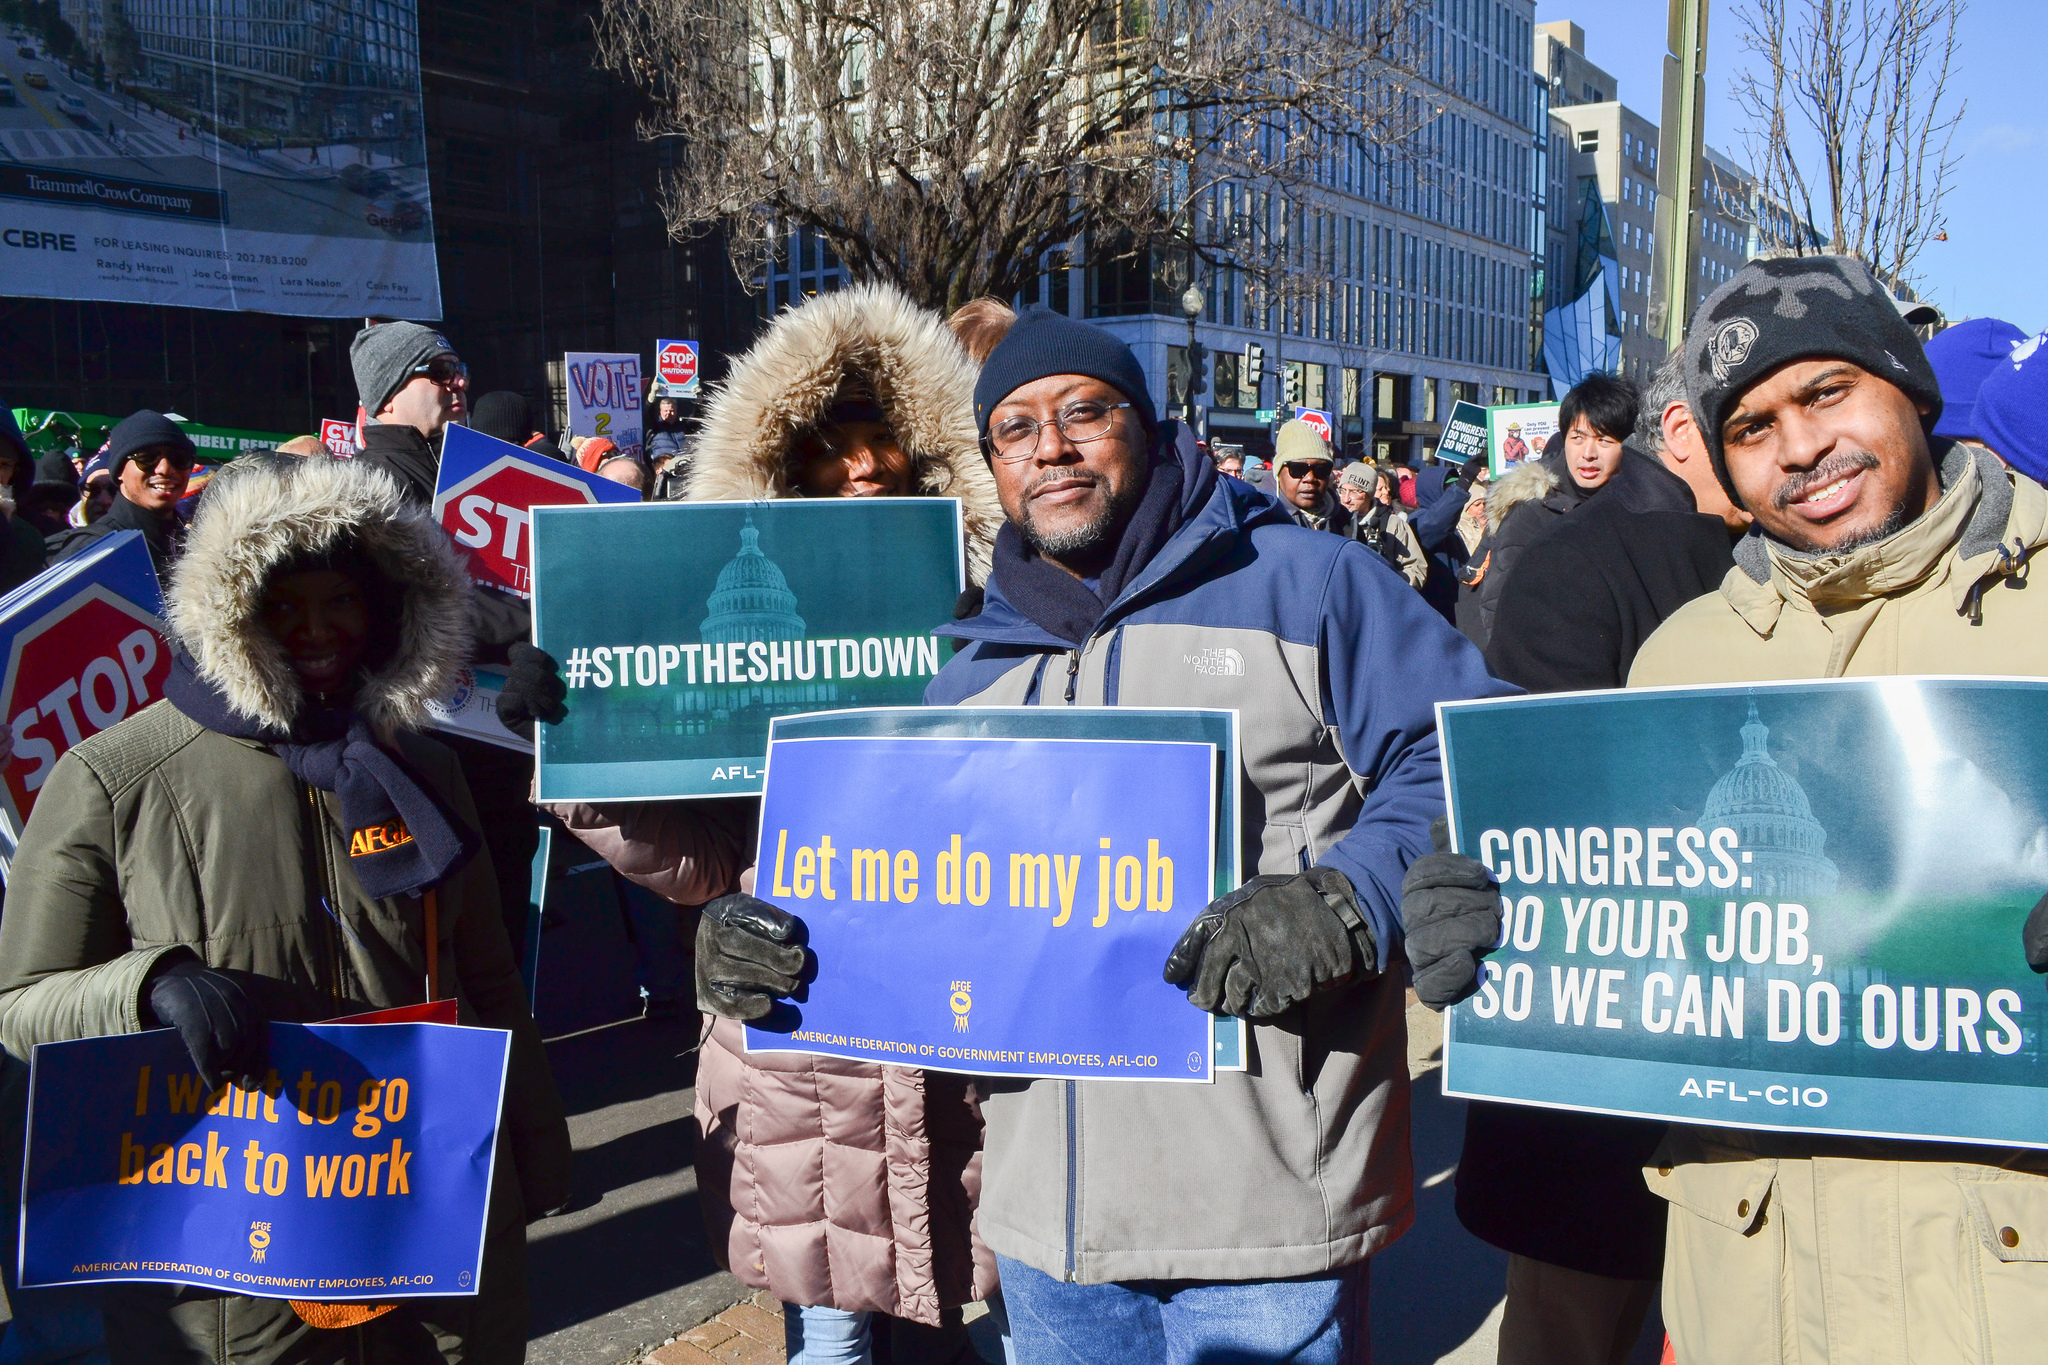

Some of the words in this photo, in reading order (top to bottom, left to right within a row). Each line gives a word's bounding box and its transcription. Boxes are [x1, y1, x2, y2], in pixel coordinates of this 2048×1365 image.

[3, 228, 77, 252] CBRE
[94, 237, 119, 248] FOR
[122, 240, 170, 254] LEASING
[236, 252, 308, 267] 202.783.8200
[96, 259, 132, 273] Randy
[136, 262, 174, 275] Harrell
[192, 269, 211, 279] Joe
[280, 277, 303, 287] Lara
[305, 278, 342, 288] Nealon
[366, 281, 389, 291] Colin
[392, 283, 409, 294] Fay
[661, 352, 695, 365] STOP
[570, 359, 640, 411] VOTE
[327, 424, 356, 441] CW
[595, 413, 612, 435] 2
[1450, 420, 1488, 438] CONGRESS
[185, 434, 236, 450] NBELT
[239, 438, 285, 452] RENT
[326, 438, 355, 455] STR
[1444, 439, 1454, 449] SO
[1455, 442, 1466, 454] WE
[1447, 430, 1457, 440] DO
[1459, 433, 1479, 446] YOUR
[1348, 474, 1370, 487] FLINT
[454, 494, 529, 560] ST
[1183, 654, 1225, 666] NORTH
[1203, 648, 1225, 657] THE
[565, 636, 939, 689] #STOPTHESHUTDOWN
[1194, 665, 1225, 676] FACE
[11, 628, 158, 792] STOP
[711, 765, 765, 781] AFL-
[1479, 826, 1753, 889] CONGRESS:
[772, 829, 836, 901] Let
[851, 847, 919, 904] me
[936, 834, 991, 907] do
[1009, 852, 1081, 928] my
[1092, 837, 1174, 928] job
[1560, 897, 1689, 960] YOUR
[1705, 901, 1824, 976] JOB,
[950, 980, 972, 992] AFGE
[1472, 960, 1534, 1022] SO
[1550, 965, 1626, 1029] WE
[1641, 971, 1745, 1039] CAN
[1767, 979, 1841, 1046] DO
[1861, 983, 2023, 1056] OURS
[791, 1030, 848, 1047] AMERICAN
[850, 1036, 917, 1055] FEDERATION
[920, 1044, 935, 1057] OF
[937, 1046, 1025, 1063] GOVERNMENT
[1028, 1051, 1105, 1068] EMPLOYEES,
[1107, 1054, 1158, 1067] AFL-CIO
[135, 1065, 150, 1117] I
[167, 1068, 283, 1124] want
[297, 1071, 342, 1125] to
[352, 1077, 410, 1138] go
[1679, 1077, 1829, 1108] AFL-CIO
[118, 1131, 230, 1189] back
[243, 1140, 289, 1196] to
[305, 1138, 413, 1198] work
[250, 1221, 272, 1232] AFGE
[72, 1261, 138, 1274] AMERICAN
[141, 1261, 213, 1277] FEDERATION
[215, 1269, 230, 1280] OF
[233, 1272, 316, 1289] GOVERNMENT
[318, 1277, 387, 1289] EMPLOYEES,
[390, 1274, 434, 1286] AFL-CIO
